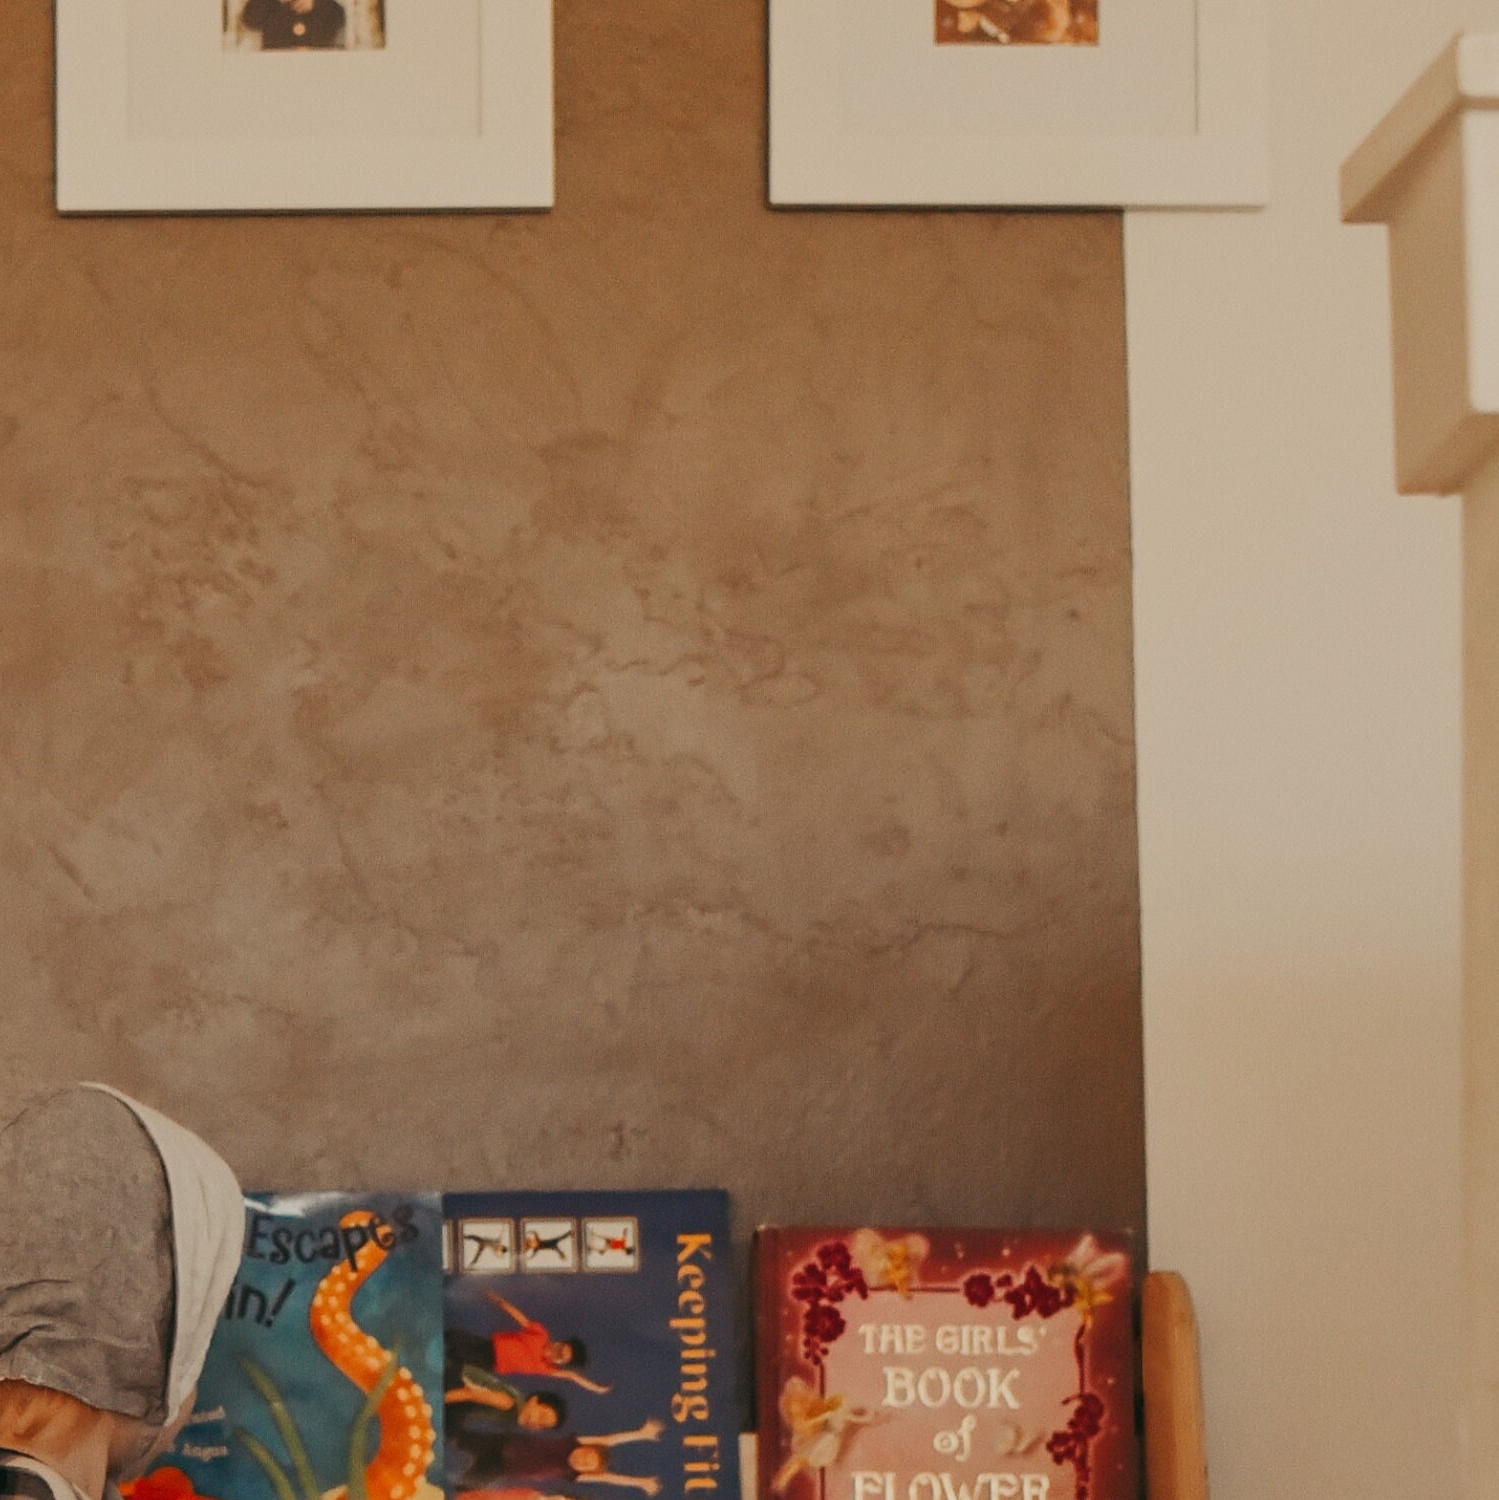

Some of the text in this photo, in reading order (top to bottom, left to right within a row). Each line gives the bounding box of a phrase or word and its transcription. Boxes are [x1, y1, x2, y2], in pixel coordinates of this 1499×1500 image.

[246, 1205, 419, 1272] Escapes
[669, 1233, 717, 1422] Keeping
[857, 1323, 1048, 1356] THE GIRLS'
[882, 1366, 1020, 1410] BOOK
[933, 1413, 977, 1462] of
